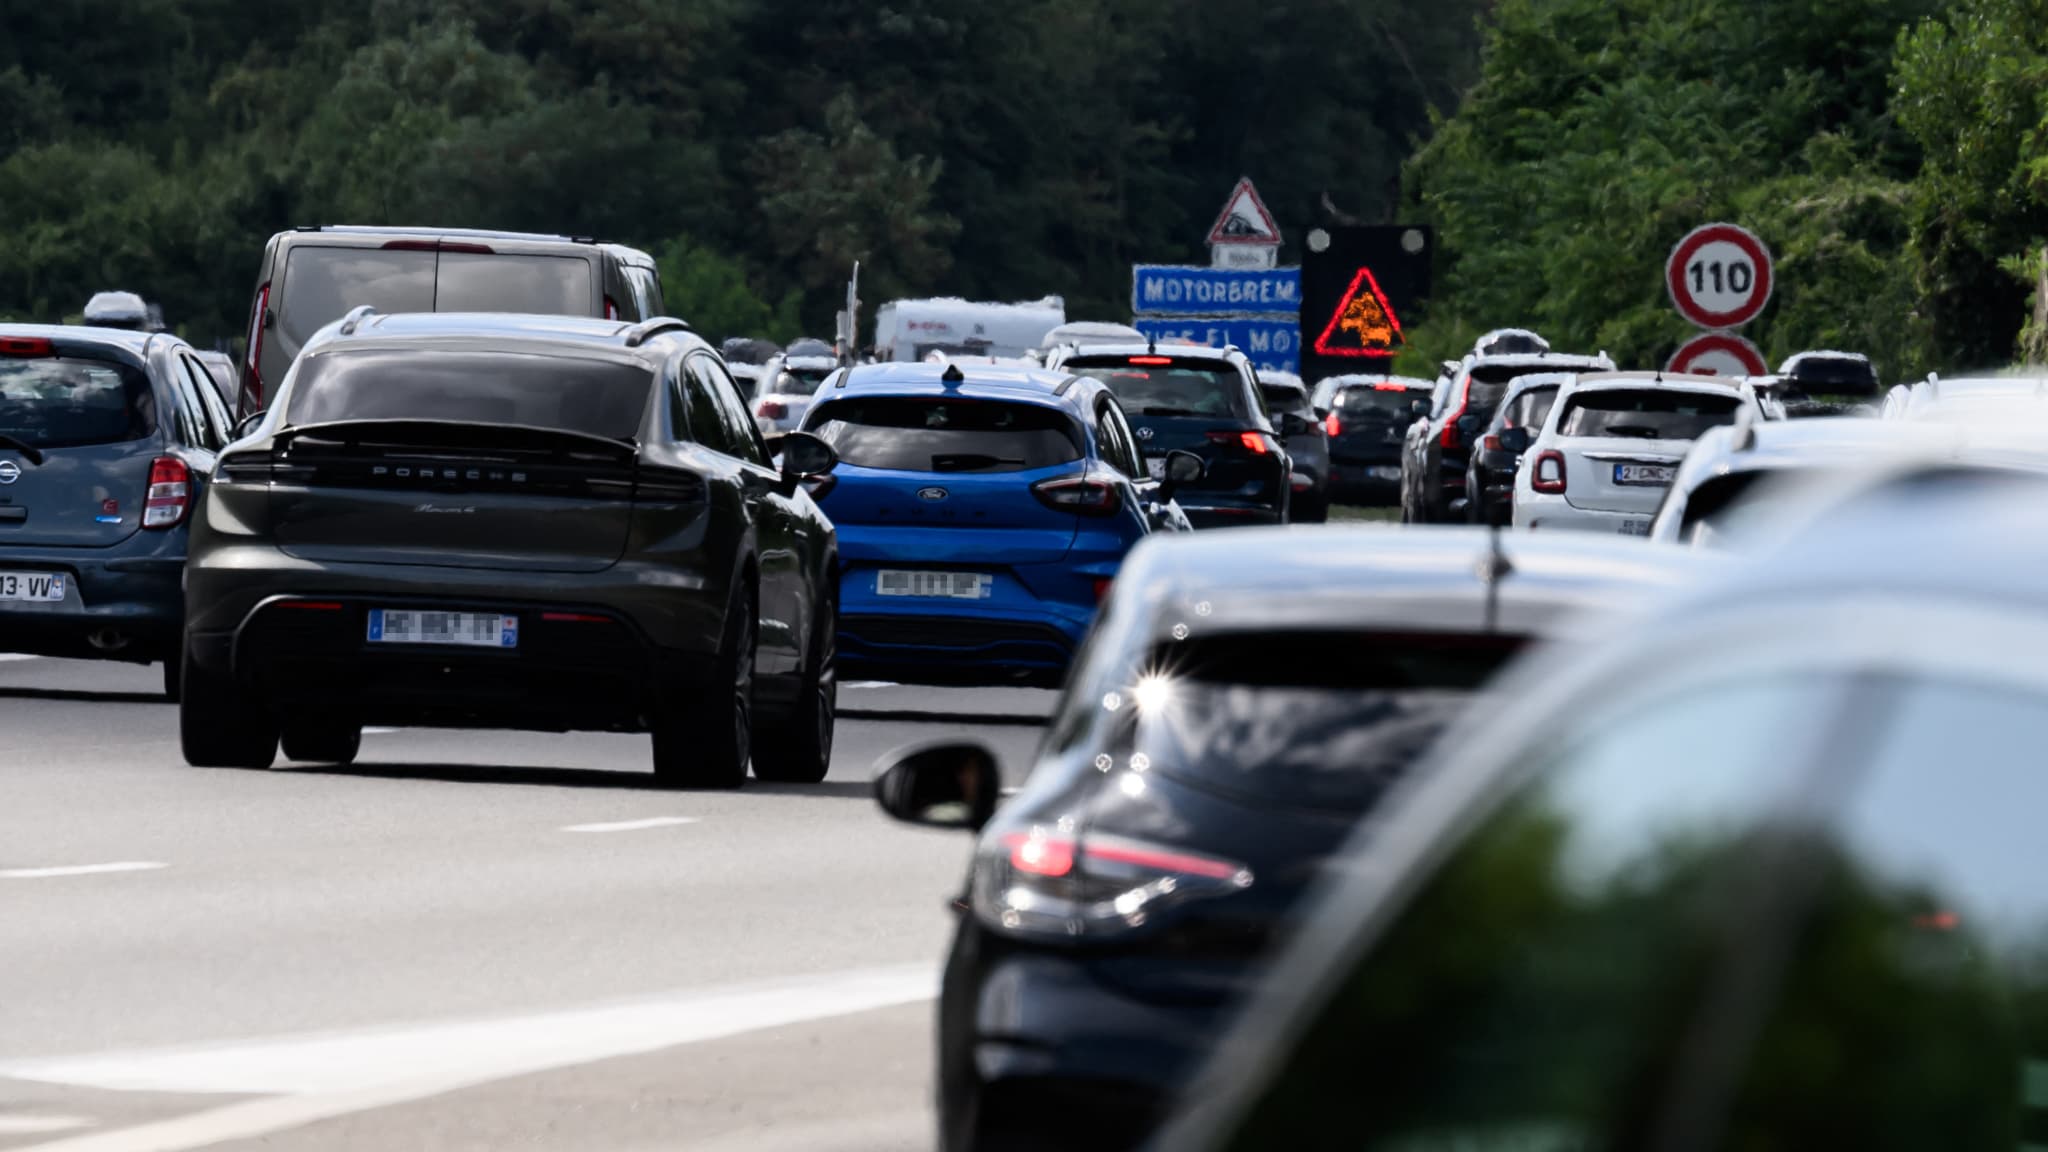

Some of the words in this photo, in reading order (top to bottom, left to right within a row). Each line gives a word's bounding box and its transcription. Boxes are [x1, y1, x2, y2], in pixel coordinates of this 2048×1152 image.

[1144, 277, 1301, 302] MOTORBREM
[1690, 261, 1751, 294] 110
[372, 466, 527, 482] PORSCHE
